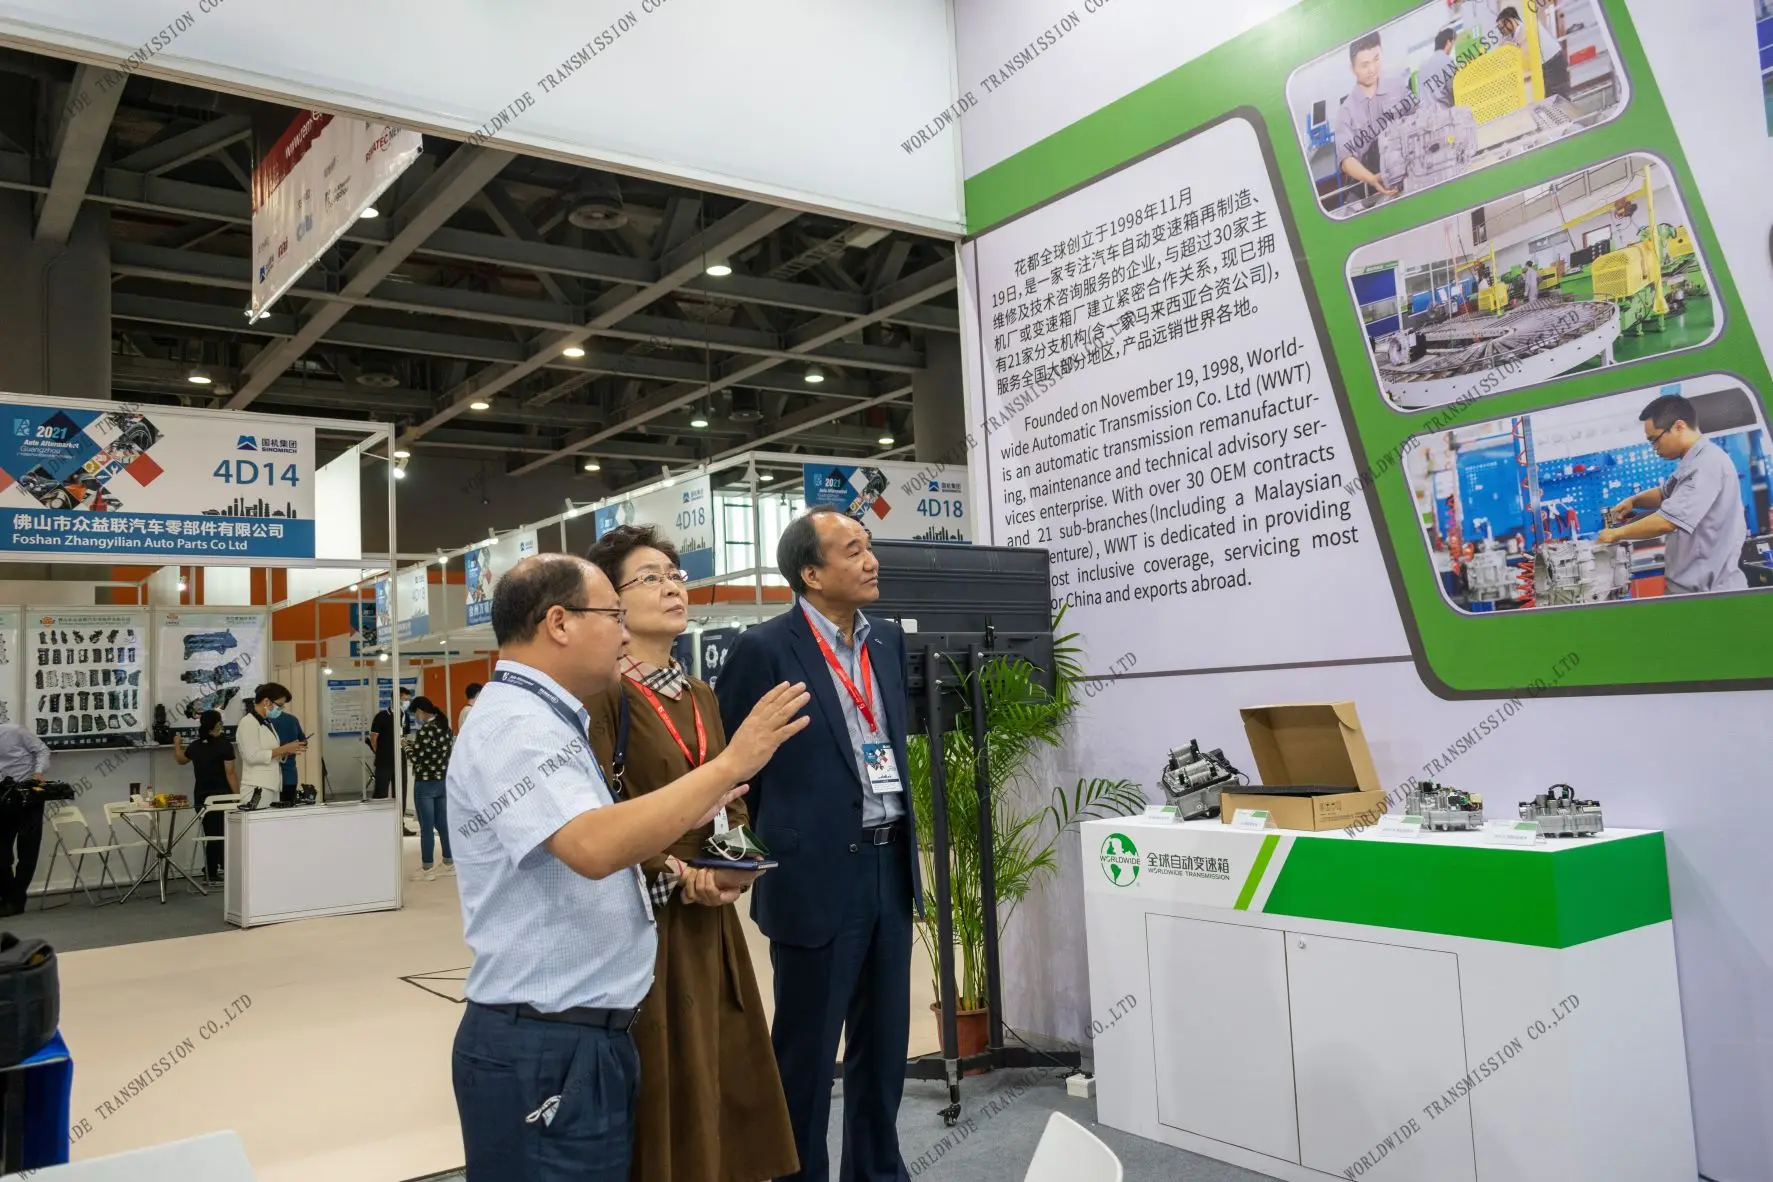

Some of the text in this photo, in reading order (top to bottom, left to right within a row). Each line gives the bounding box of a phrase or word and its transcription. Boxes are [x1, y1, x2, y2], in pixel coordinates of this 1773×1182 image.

[1014, 186, 1193, 277] 花都全球创立于1998年11月
[1024, 336, 1304, 431] Founded on November 19, 1998, World-
[1000, 360, 1311, 460] wide Automatic Transmission Co. Ltd (WWT)
[36, 425, 68, 440] 2021
[261, 438, 297, 449] 国机集团
[1002, 393, 1320, 482] is an automatic transmission remanufactur-
[213, 459, 300, 487] 4D14
[1003, 420, 1327, 506] ing, maintenance and technical advisory ser-
[1005, 445, 1335, 526] vices enterprise. With over 30 OEM contracts
[675, 506, 705, 530] 4D18
[916, 498, 964, 518] 4D18
[1007, 473, 1342, 547] and 21 sub-branches (Including a Malaysian
[12, 533, 248, 550] Foshan Zhangyilian Auto Parts Co Ltd
[13, 513, 284, 539] 佛山市众益联汽车零部件有限公司
[1050, 499, 1352, 563] enture), WWT is dedicated in providing
[1051, 526, 1359, 587] ost inclusive coverage, servicing most
[1050, 568, 1252, 610] or China and exports abroad.
[1100, 854, 1141, 865] WORLDWIDE
[1146, 852, 1230, 874] 全球自动变速箱
[1147, 867, 1230, 881] WORLDWIDE TRANSMISSION
